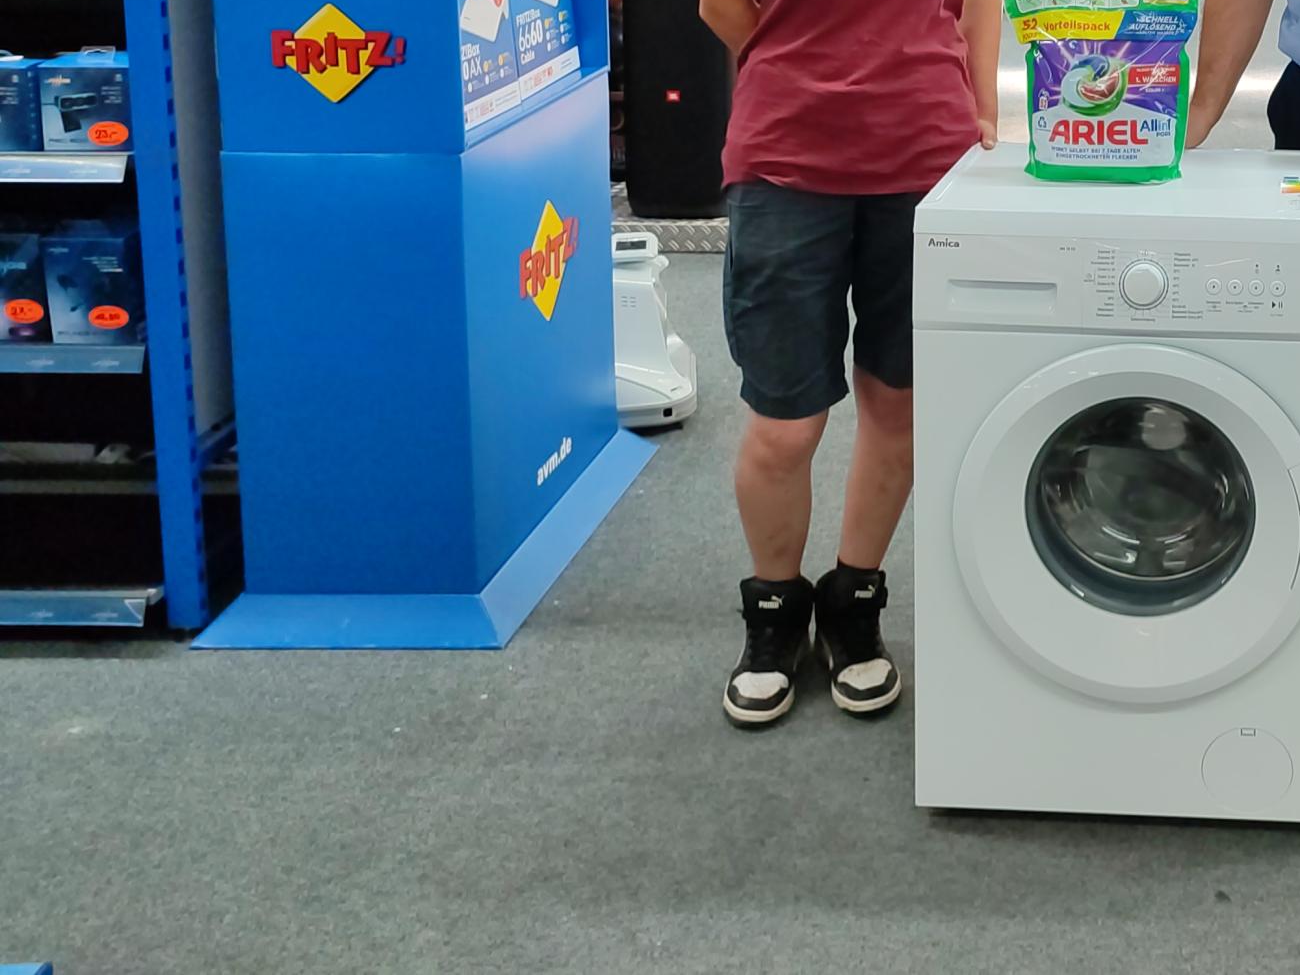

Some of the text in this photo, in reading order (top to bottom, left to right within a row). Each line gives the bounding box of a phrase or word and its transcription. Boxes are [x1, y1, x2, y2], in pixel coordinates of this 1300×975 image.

[518, 19, 543, 52] 6660
[1022, 19, 1038, 30] 52
[271, 29, 406, 75] FRITZ!
[470, 56, 482, 77] AX
[1049, 119, 1149, 146] ARIEL
[928, 237, 960, 248] Amica
[519, 216, 579, 301] FRITZ!
[537, 436, 573, 487] avm.de
